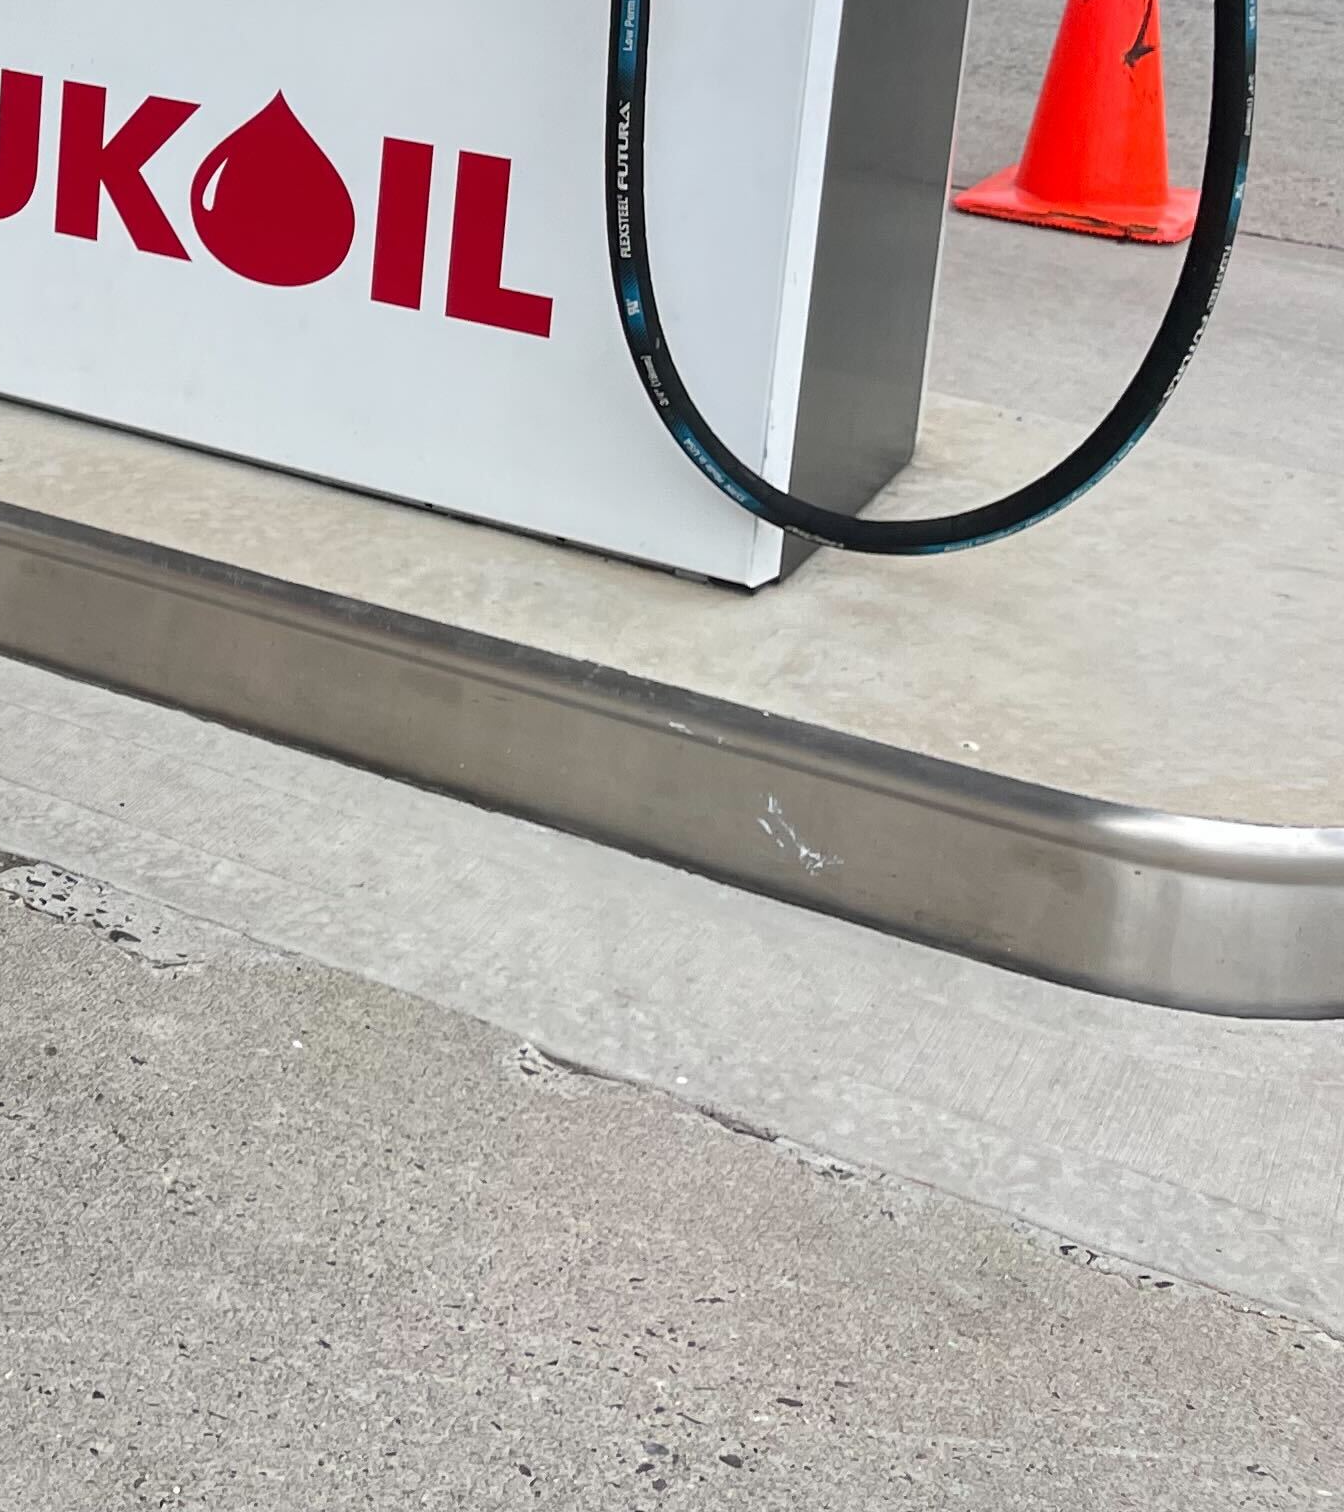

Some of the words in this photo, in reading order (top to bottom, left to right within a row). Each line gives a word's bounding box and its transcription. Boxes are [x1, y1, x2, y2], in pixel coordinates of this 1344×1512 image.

[622, 29, 634, 52] Low
[616, 100, 631, 191] FUTURA
[620, 196, 632, 259] FLEXSTEEL
